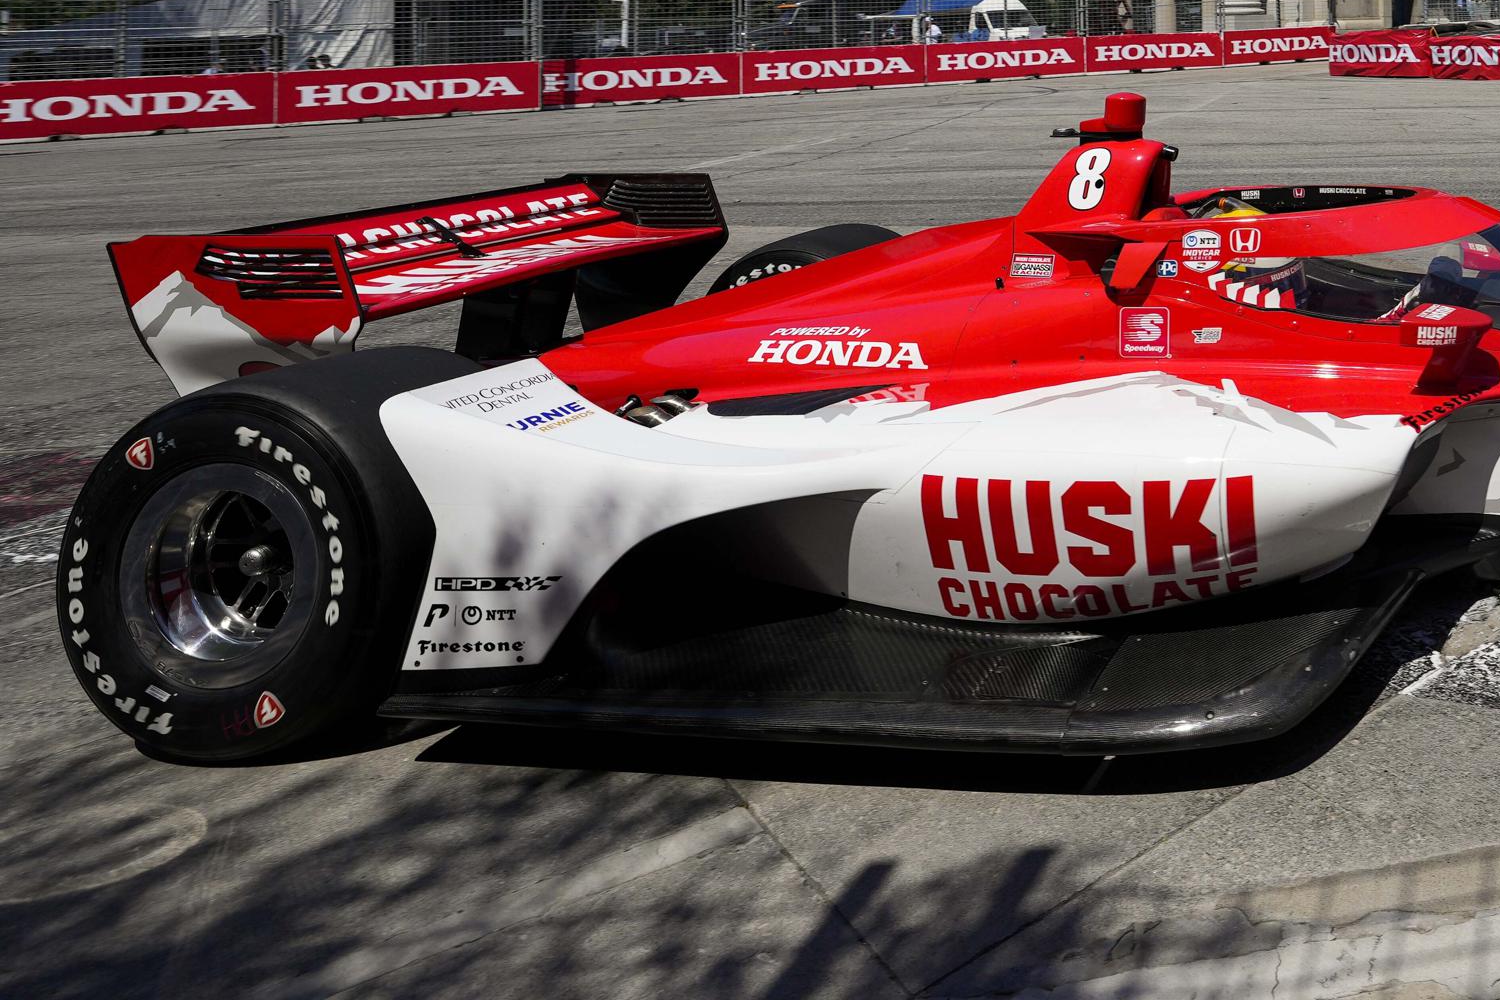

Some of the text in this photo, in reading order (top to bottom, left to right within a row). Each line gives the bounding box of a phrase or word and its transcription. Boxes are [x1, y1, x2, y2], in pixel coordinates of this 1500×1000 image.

[1095, 42, 1215, 62] HONDA
[1231, 35, 1328, 54] HONDA
[1329, 44, 1420, 64] HONDA
[755, 56, 915, 82] HONDA
[937, 48, 1075, 71] HONDA
[544, 66, 728, 94] HONDA
[295, 76, 524, 108] HONDA
[1068, 148, 1112, 210] 8
[1335, 187, 1367, 195] CHOCOLATE
[1200, 237, 1217, 245] NTT
[1182, 249, 1220, 257] INDYCAR
[1020, 263, 1051, 271] GANASSI
[770, 326, 871, 338] POWERED by
[1417, 326, 1457, 339] HUSKI
[747, 340, 929, 370] HONDA
[1124, 344, 1165, 354] Speedway
[477, 390, 534, 413] DENTAL
[538, 409, 595, 433] REWARDS
[234, 426, 345, 628] Firestone
[921, 474, 1258, 577] HUSKI
[436, 578, 497, 590] HPD
[937, 566, 1258, 621] CHOCOLATE
[485, 609, 516, 621] NTT
[67, 537, 175, 736] Firestone
[418, 639, 526, 655] Firestone
